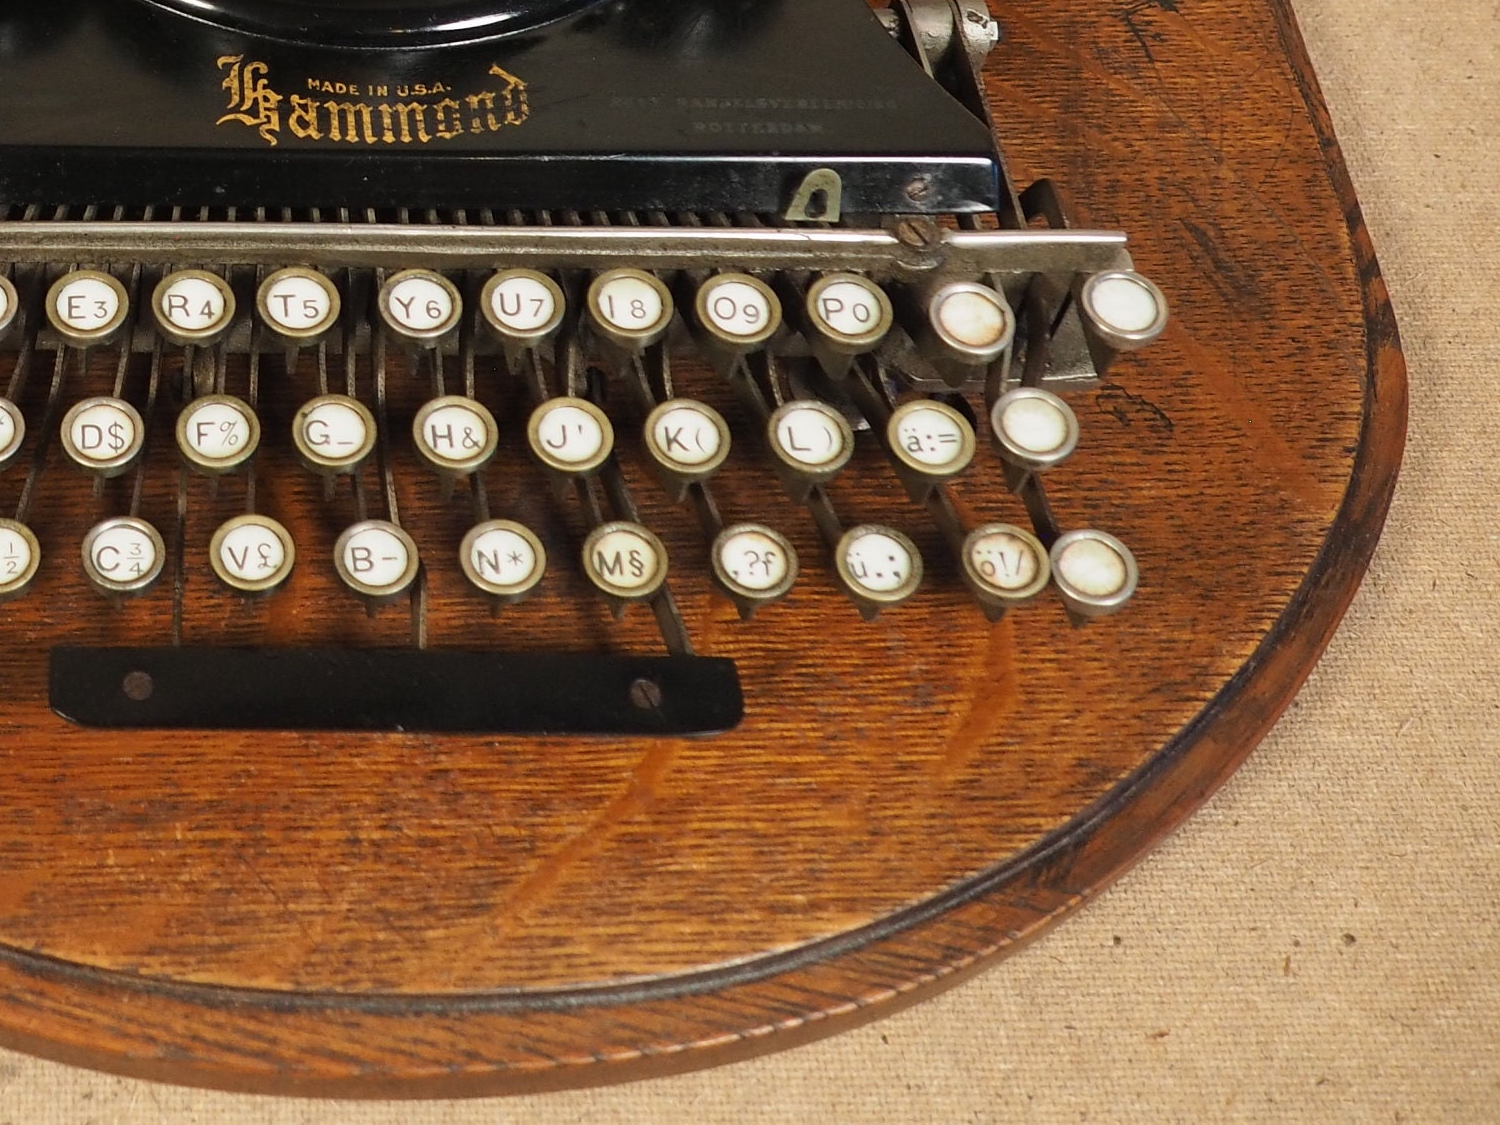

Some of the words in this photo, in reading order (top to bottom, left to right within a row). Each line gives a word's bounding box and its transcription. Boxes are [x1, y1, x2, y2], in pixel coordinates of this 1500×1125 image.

[215, 53, 529, 147] Hammond
[308, 78, 359, 96] MADE
[369, 84, 388, 97] IN
